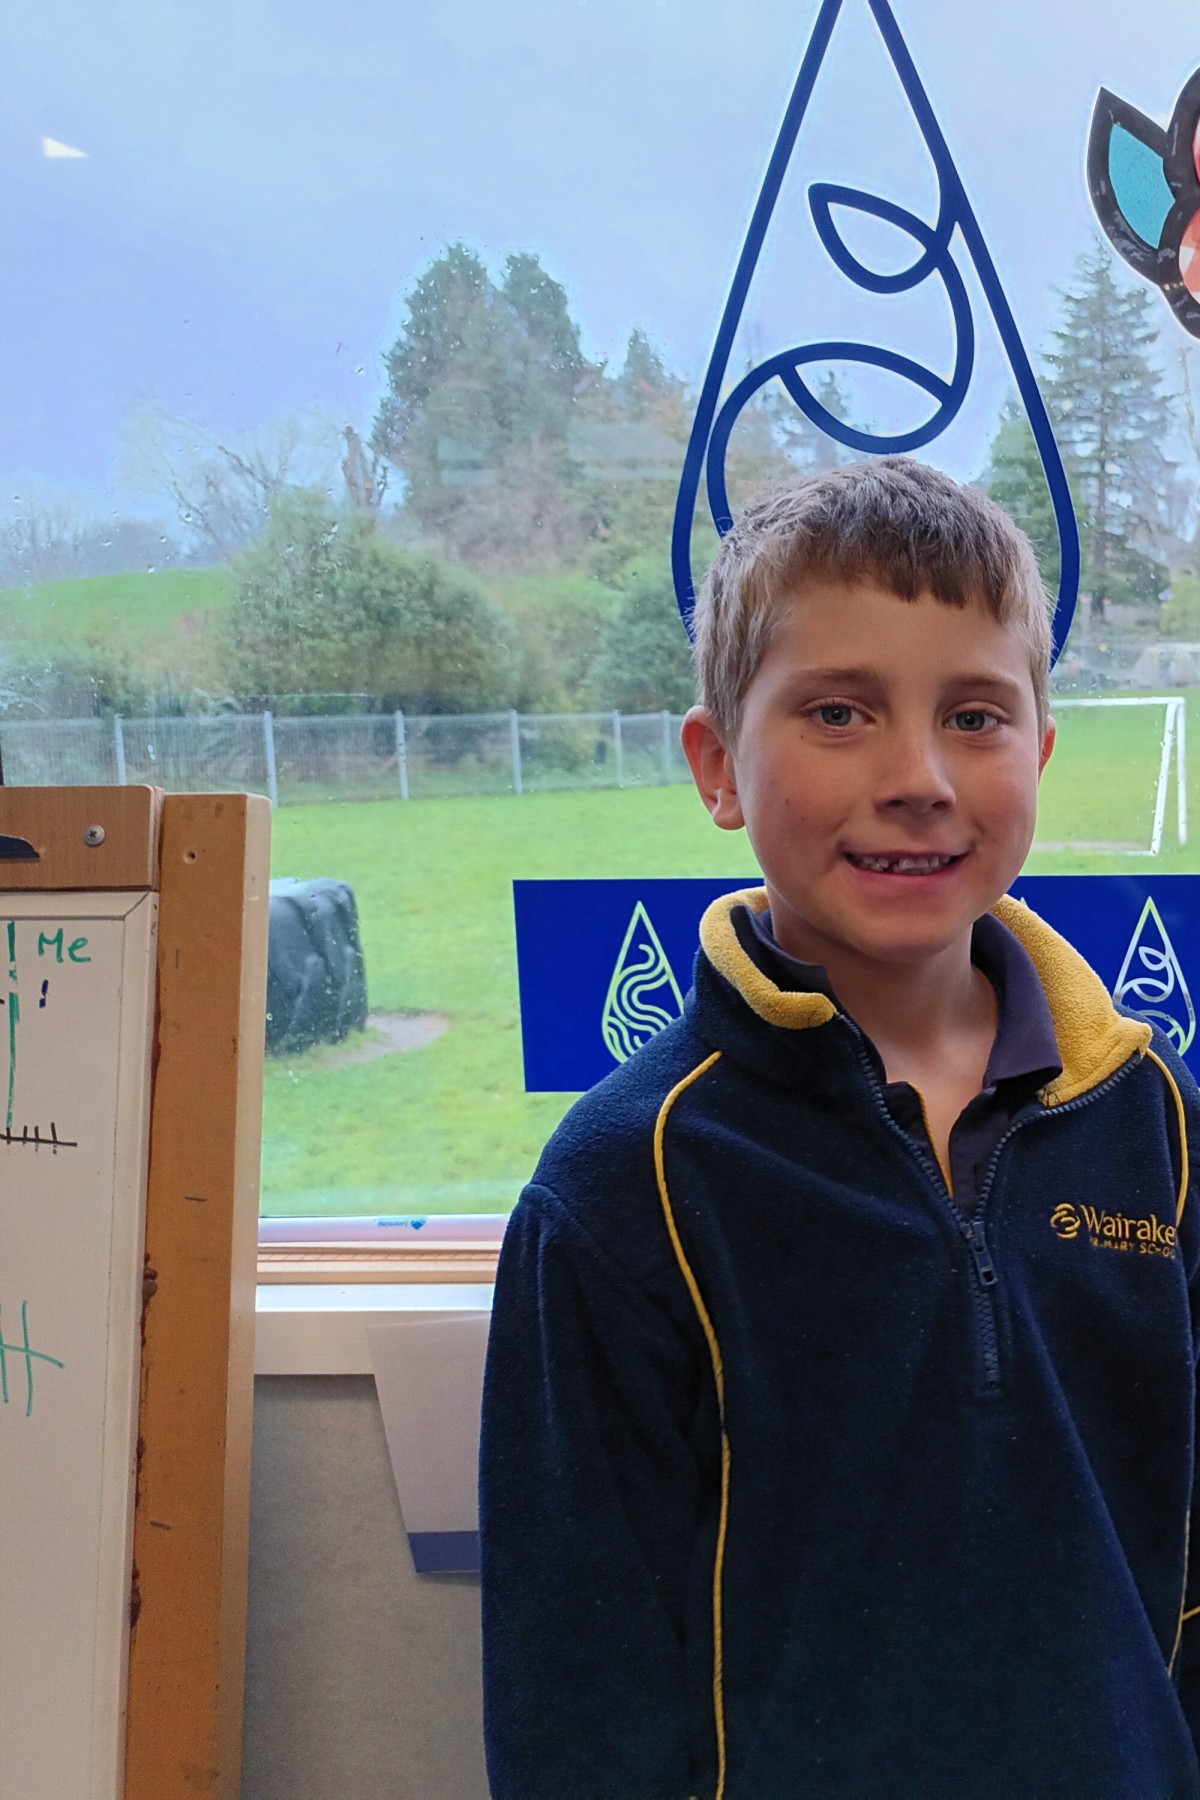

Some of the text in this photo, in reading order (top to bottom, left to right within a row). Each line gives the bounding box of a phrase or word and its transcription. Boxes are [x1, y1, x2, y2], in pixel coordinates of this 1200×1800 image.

[38, 927, 92, 964] Me
[1080, 1204, 1177, 1246] Wairake
[1139, 1242, 1176, 1259] SCHOO
